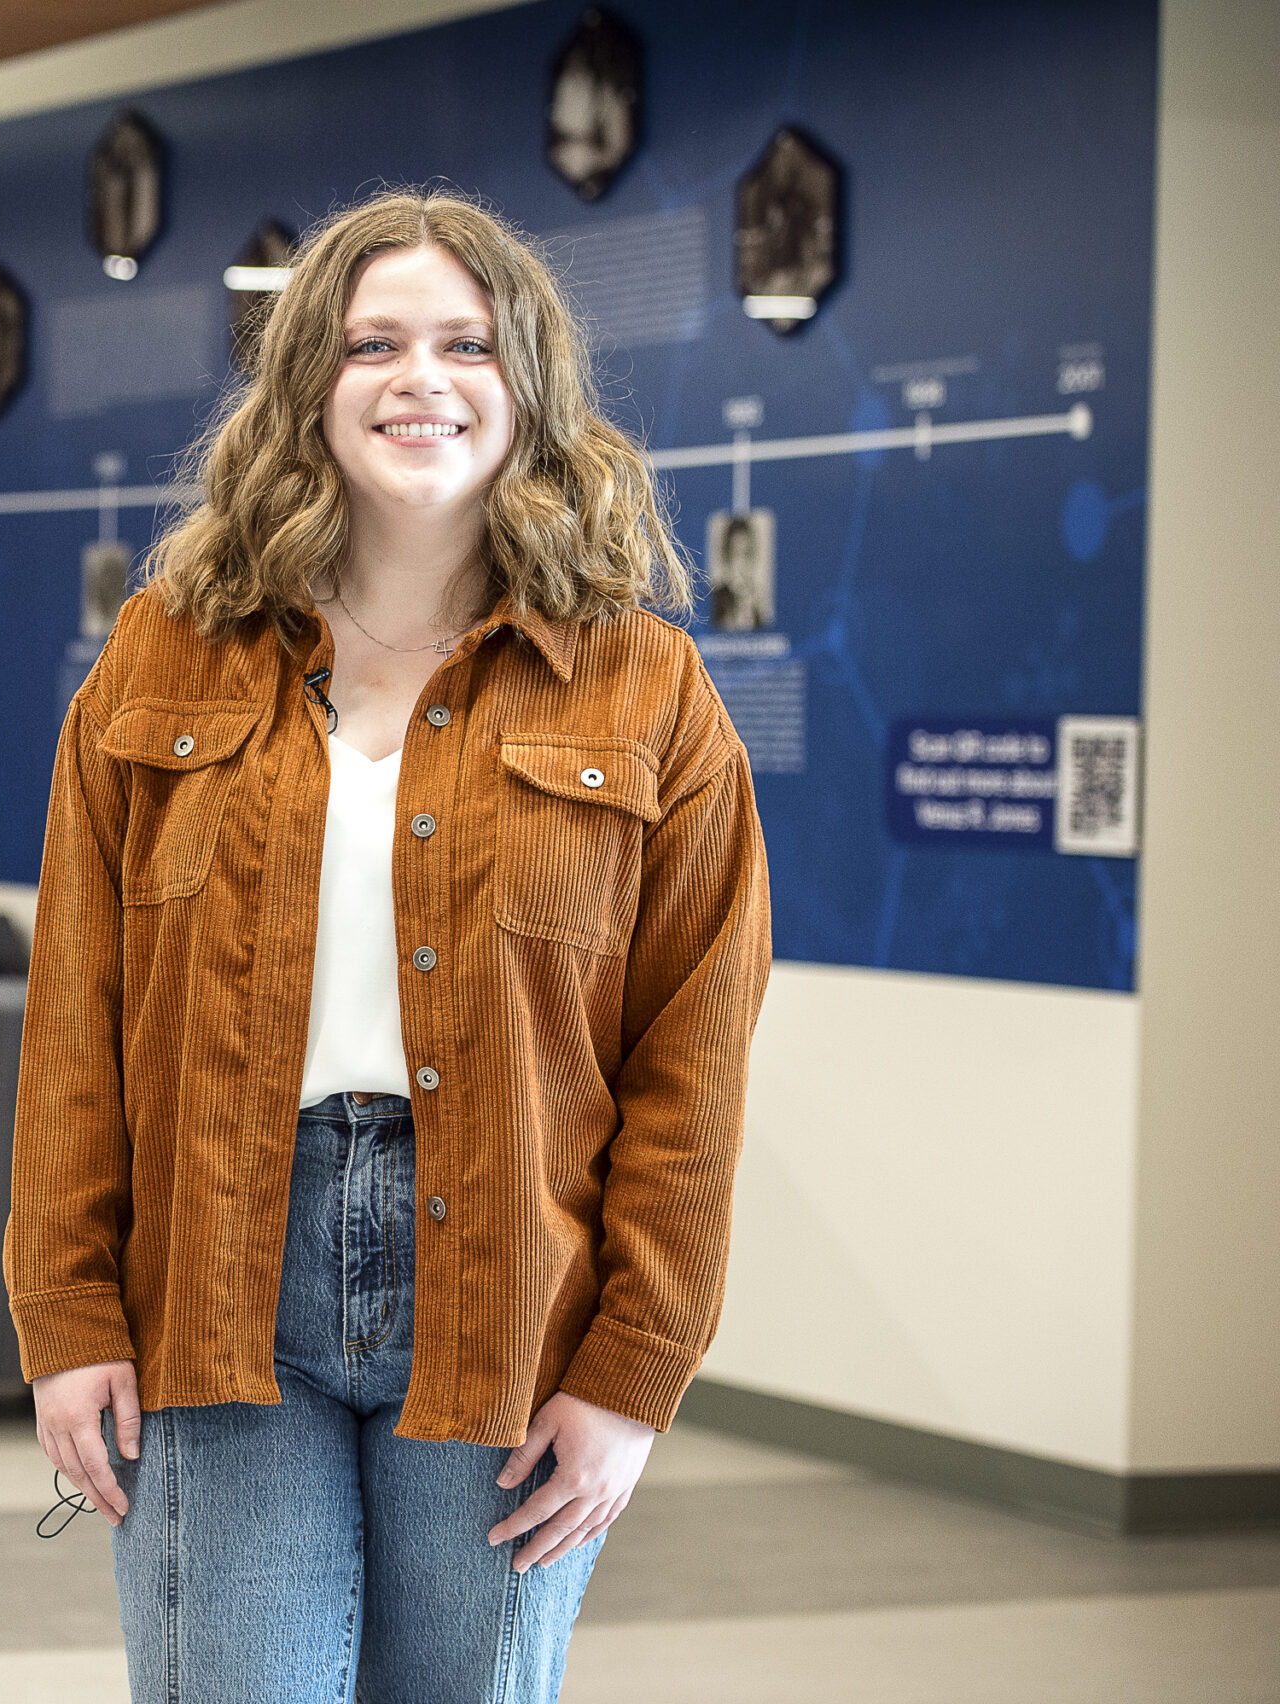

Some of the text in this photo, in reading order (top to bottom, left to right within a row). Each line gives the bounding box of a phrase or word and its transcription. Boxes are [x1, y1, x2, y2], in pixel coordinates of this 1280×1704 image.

[909, 730, 1050, 764] Scan QR code to
[914, 801, 967, 830] Venus
